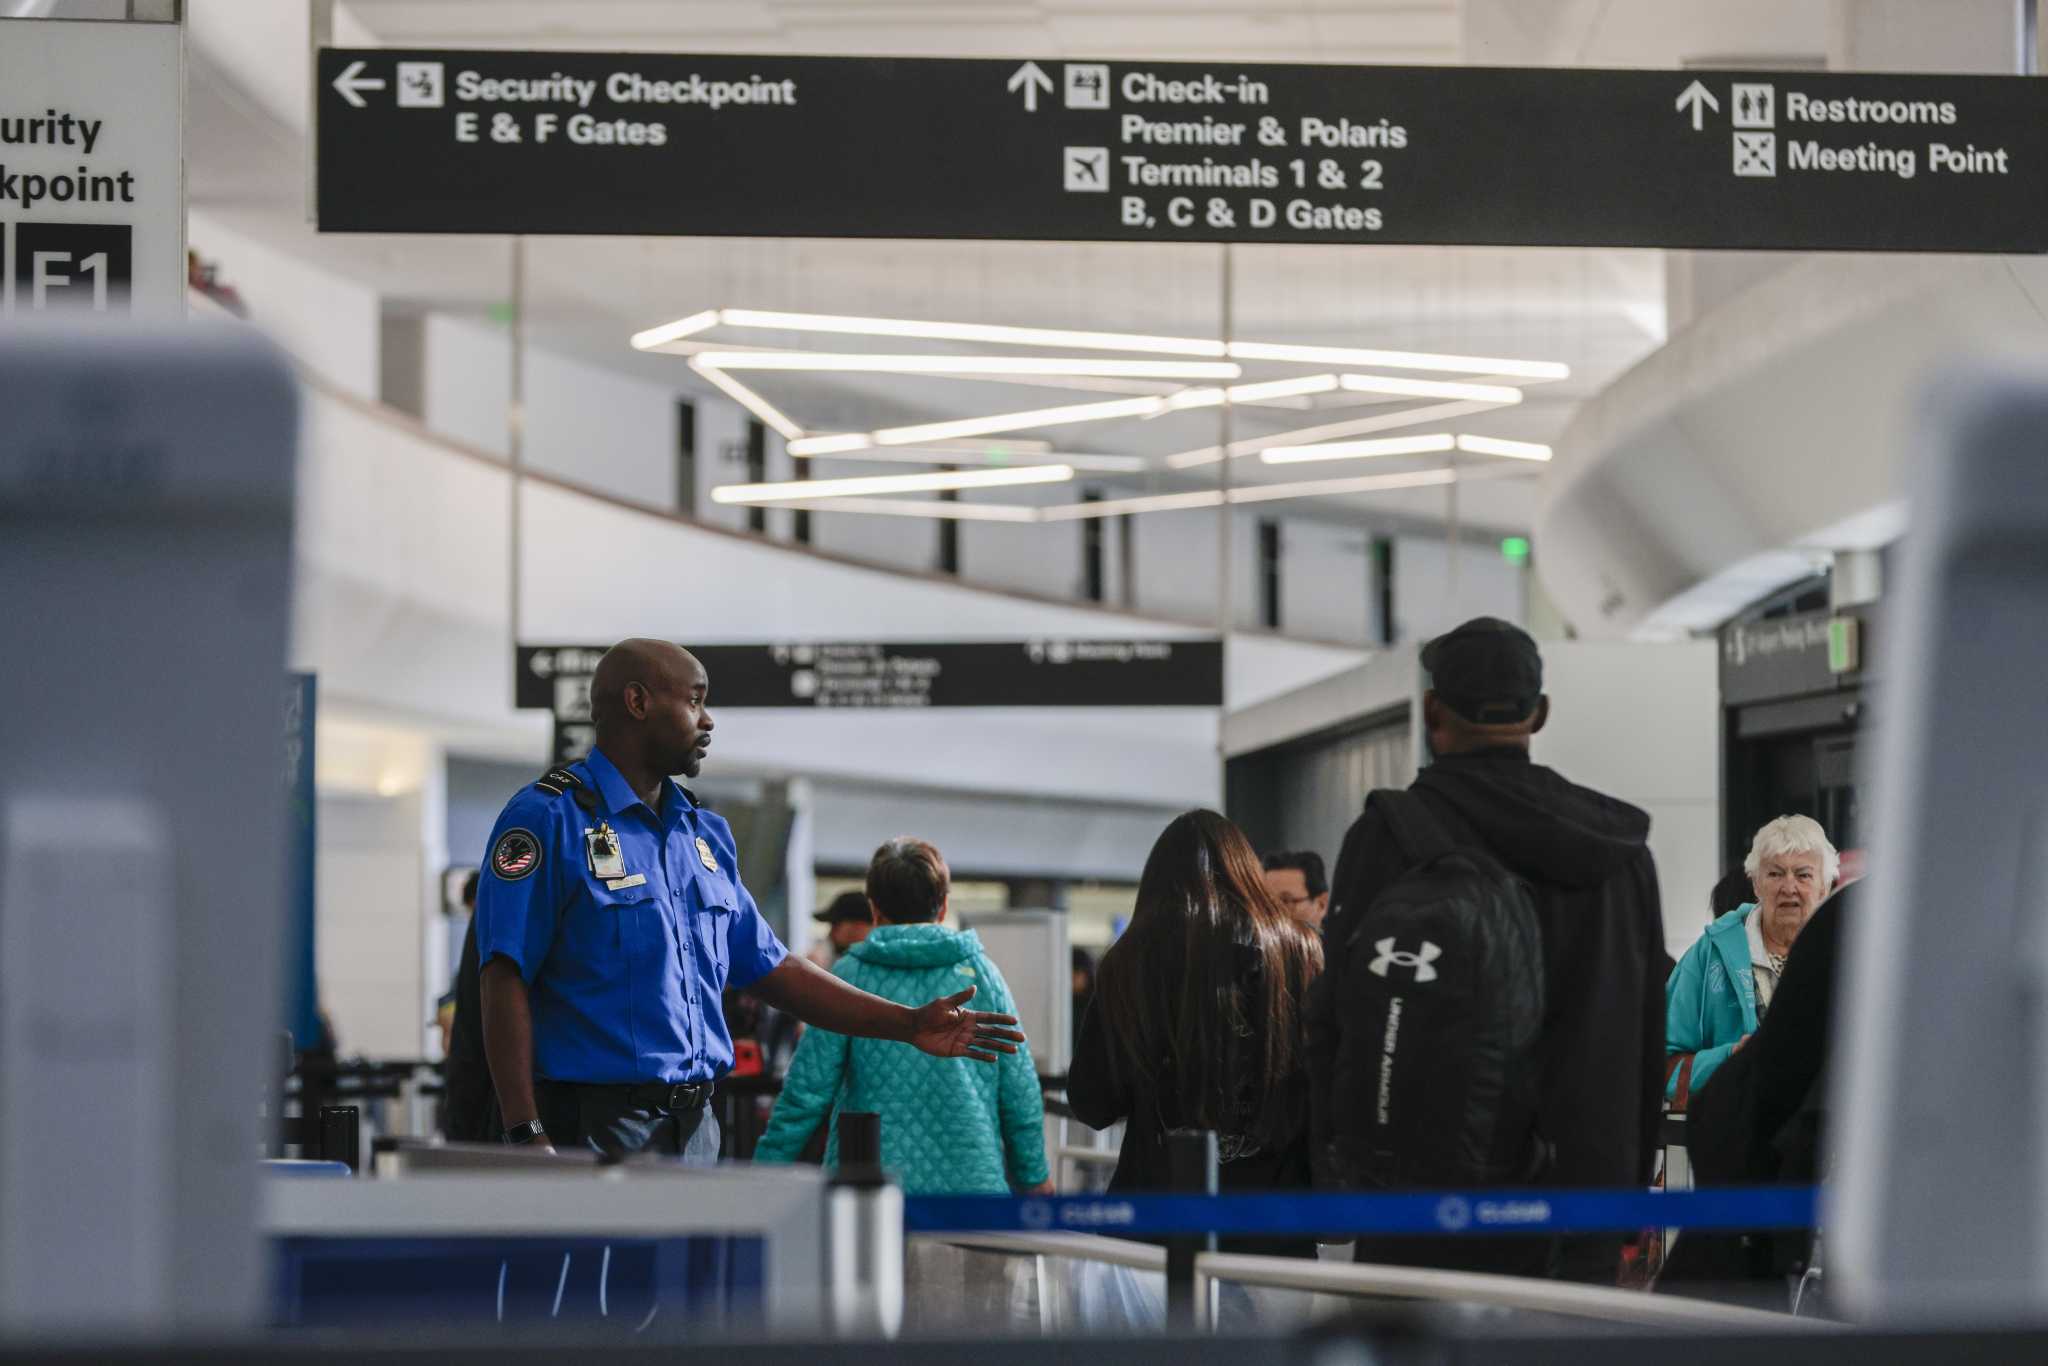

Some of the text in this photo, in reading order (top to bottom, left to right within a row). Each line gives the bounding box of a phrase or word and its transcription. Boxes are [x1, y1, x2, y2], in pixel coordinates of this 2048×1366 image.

[455, 70, 797, 110] Security Checkpoint
[1121, 72, 1269, 104] Check-in
[1786, 92, 1957, 125] Restrooms
[455, 112, 667, 146] E & F Gates
[1121, 114, 1408, 149] Premier & Polaris
[1121, 155, 1383, 190] Terminals 1 & 2
[1787, 140, 2009, 179] Meeting Point
[1121, 196, 1383, 231] B, C & D Gates
[1376, 996, 1404, 1125] UNDER ARMOUR
